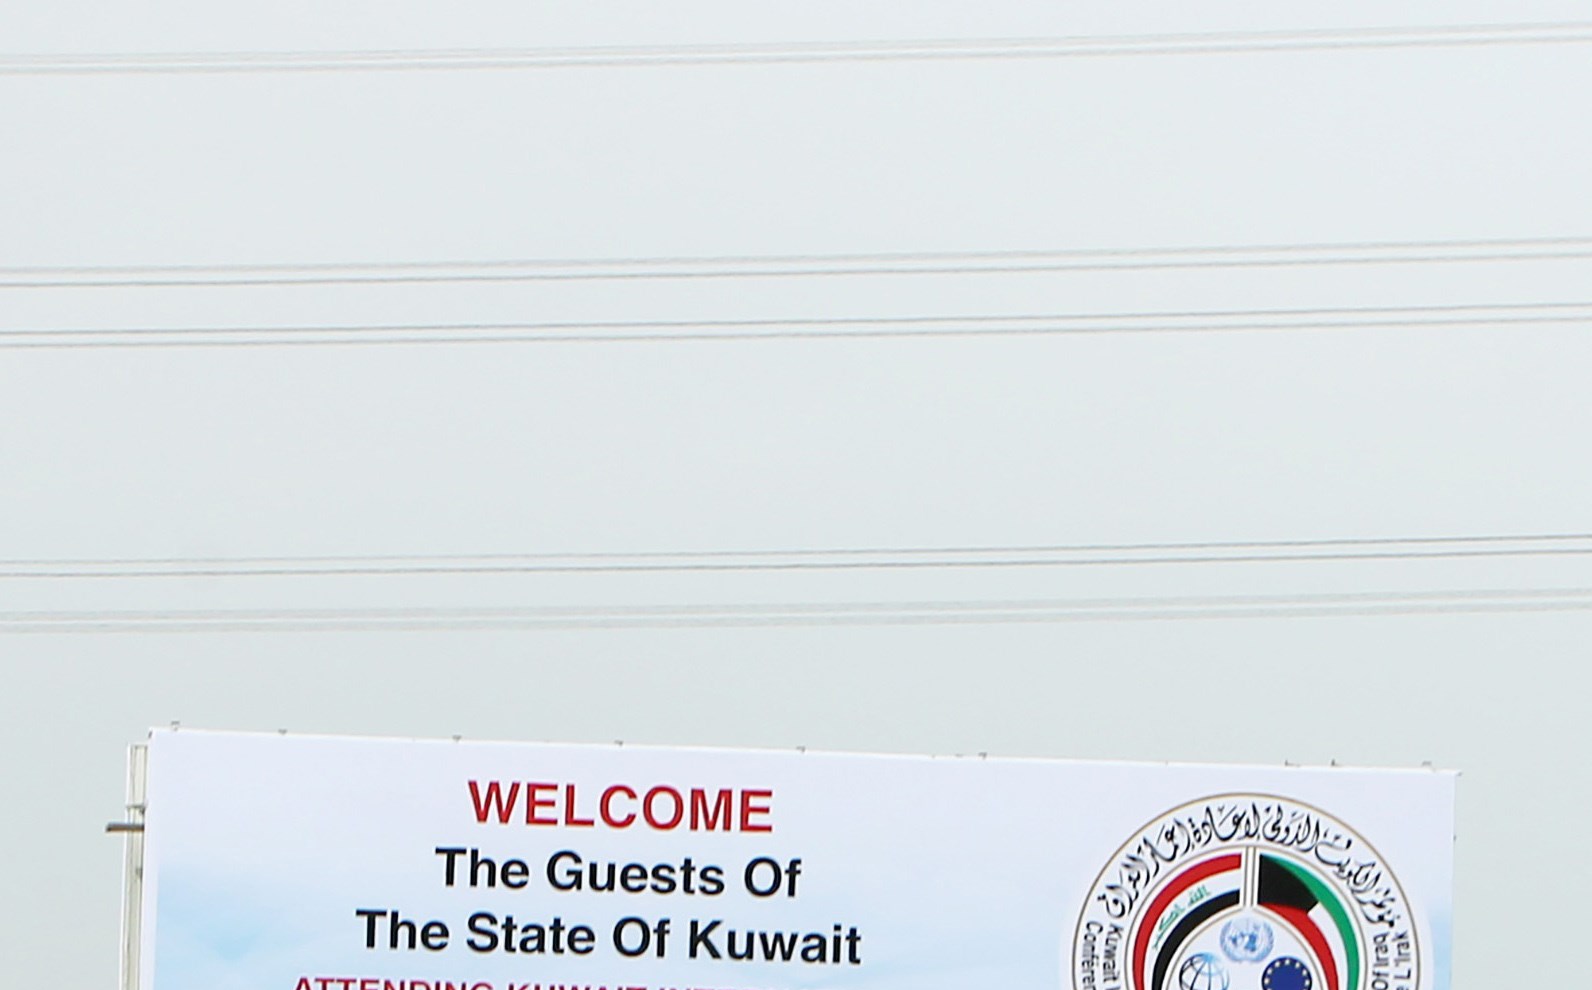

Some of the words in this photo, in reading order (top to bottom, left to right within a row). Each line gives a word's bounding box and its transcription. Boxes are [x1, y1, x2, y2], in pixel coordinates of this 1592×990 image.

[467, 780, 773, 833] WELCOME
[434, 846, 530, 890] The
[546, 849, 725, 896] Guests
[744, 856, 802, 898] Of
[355, 908, 450, 952] The
[466, 911, 596, 956] State
[612, 916, 671, 958] Of
[688, 919, 862, 965] Kuwait
[1103, 923, 1123, 982] Kuwait
[1373, 931, 1390, 968] Iraq
